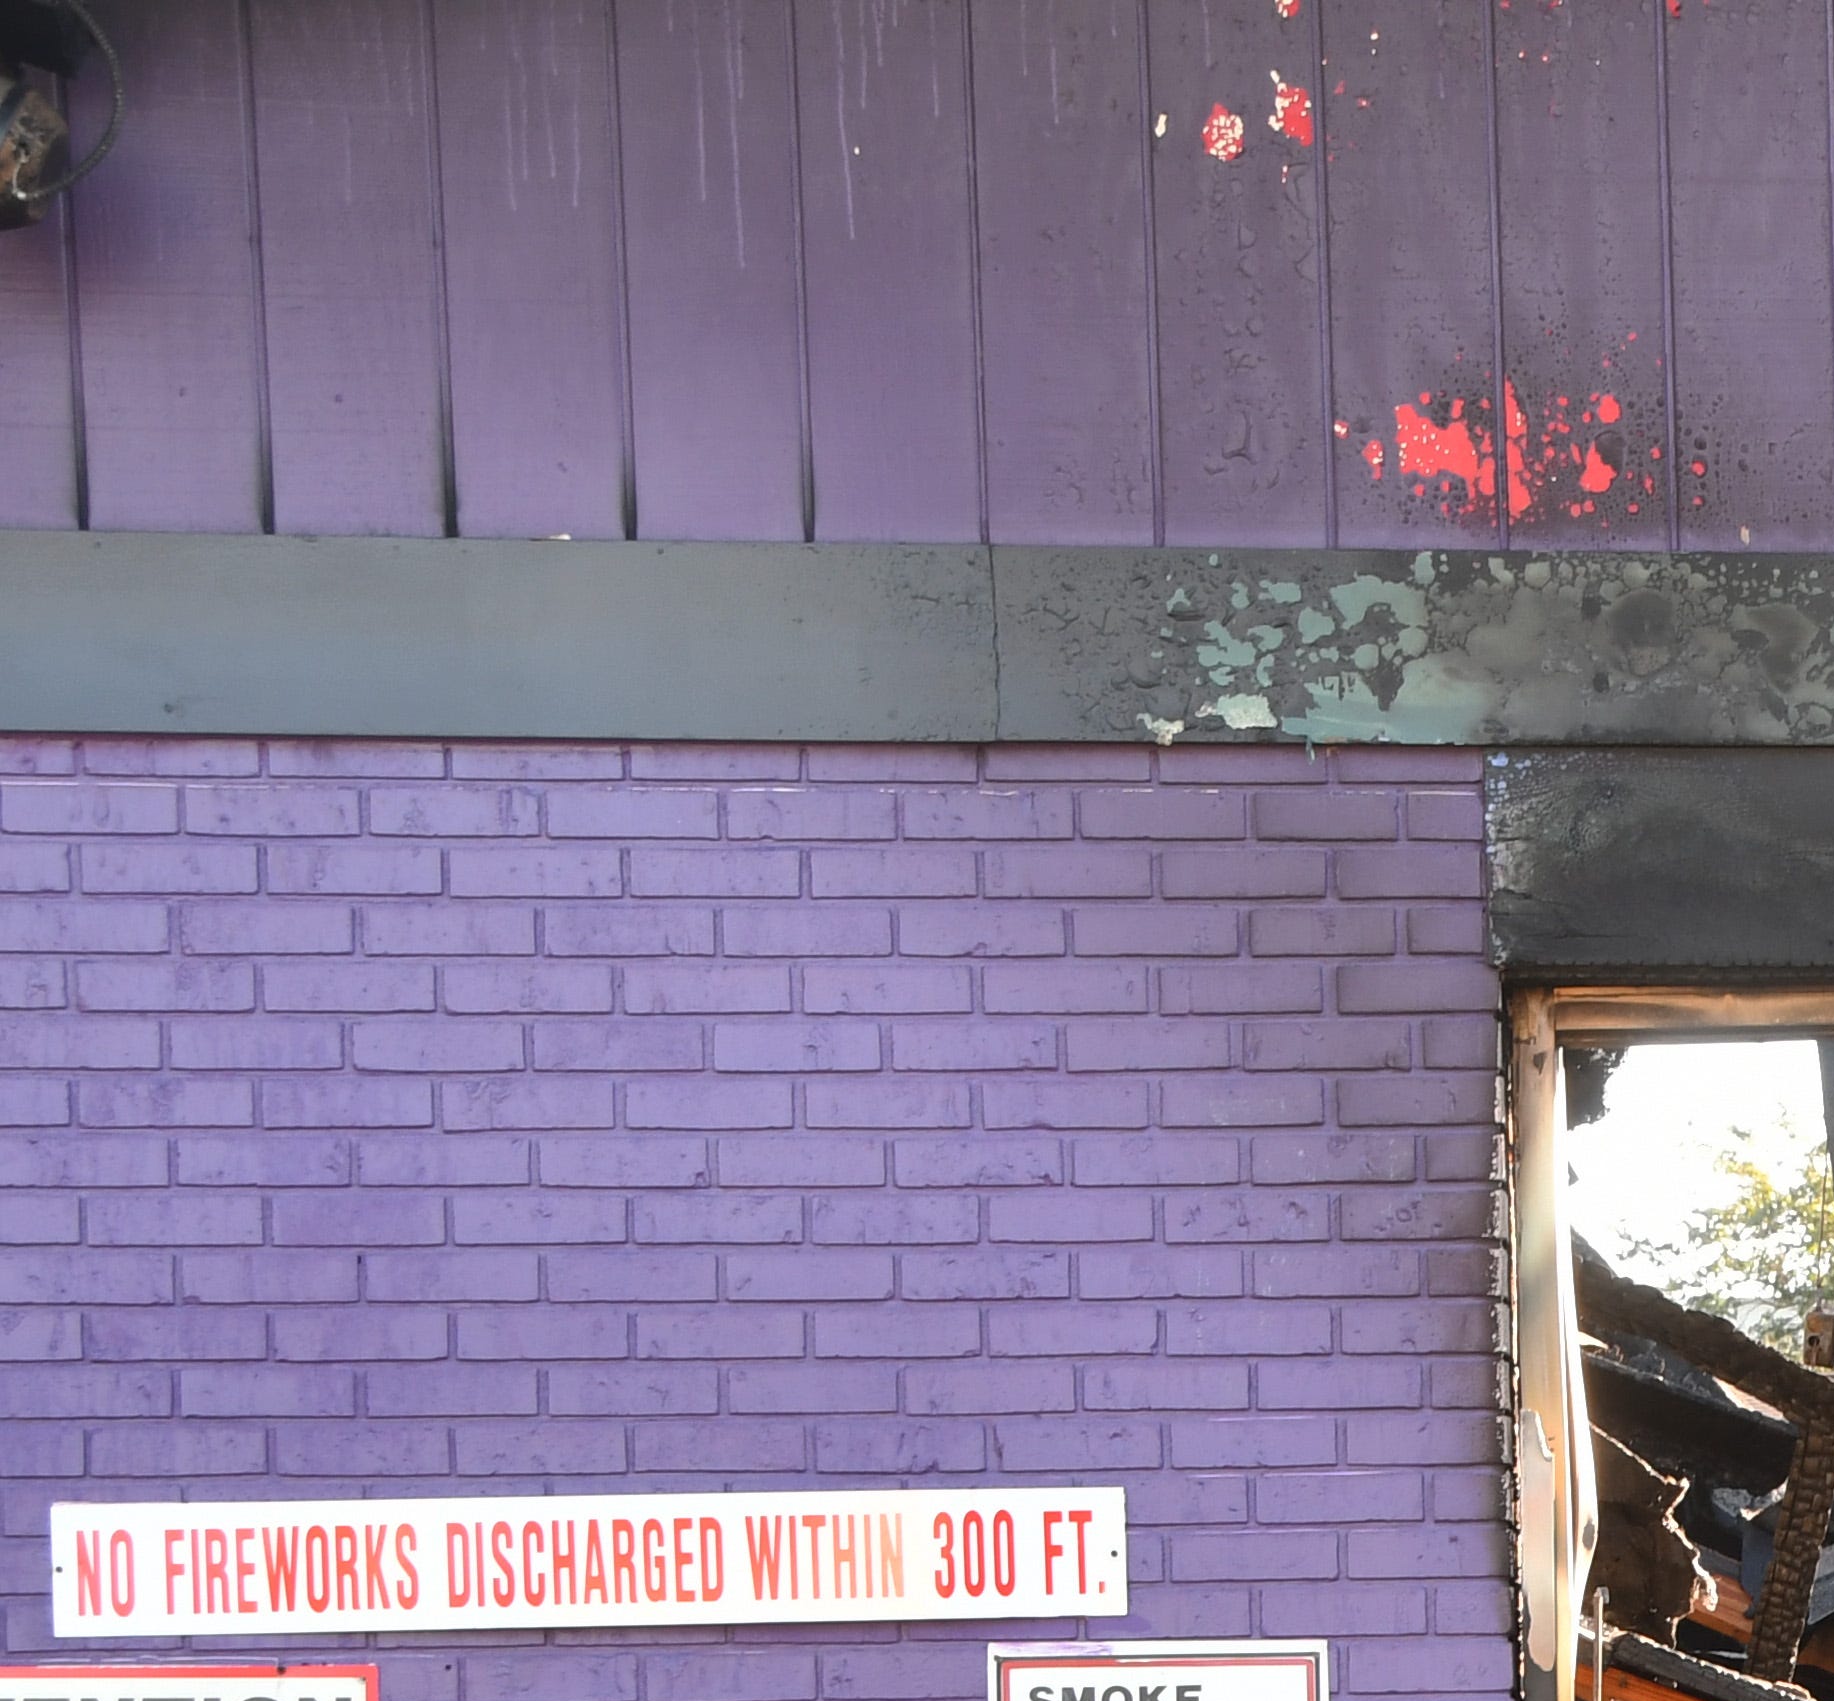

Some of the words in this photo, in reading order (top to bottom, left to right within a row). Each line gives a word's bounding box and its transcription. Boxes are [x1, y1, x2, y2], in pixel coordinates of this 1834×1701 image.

[75, 1528, 136, 1618] NO
[164, 1522, 420, 1616] FIREWORKS
[445, 1516, 725, 1609] DISCHARGED
[744, 1512, 905, 1601] WITHIN
[932, 1508, 1017, 1600] 300
[1042, 1509, 1106, 1596] FT.
